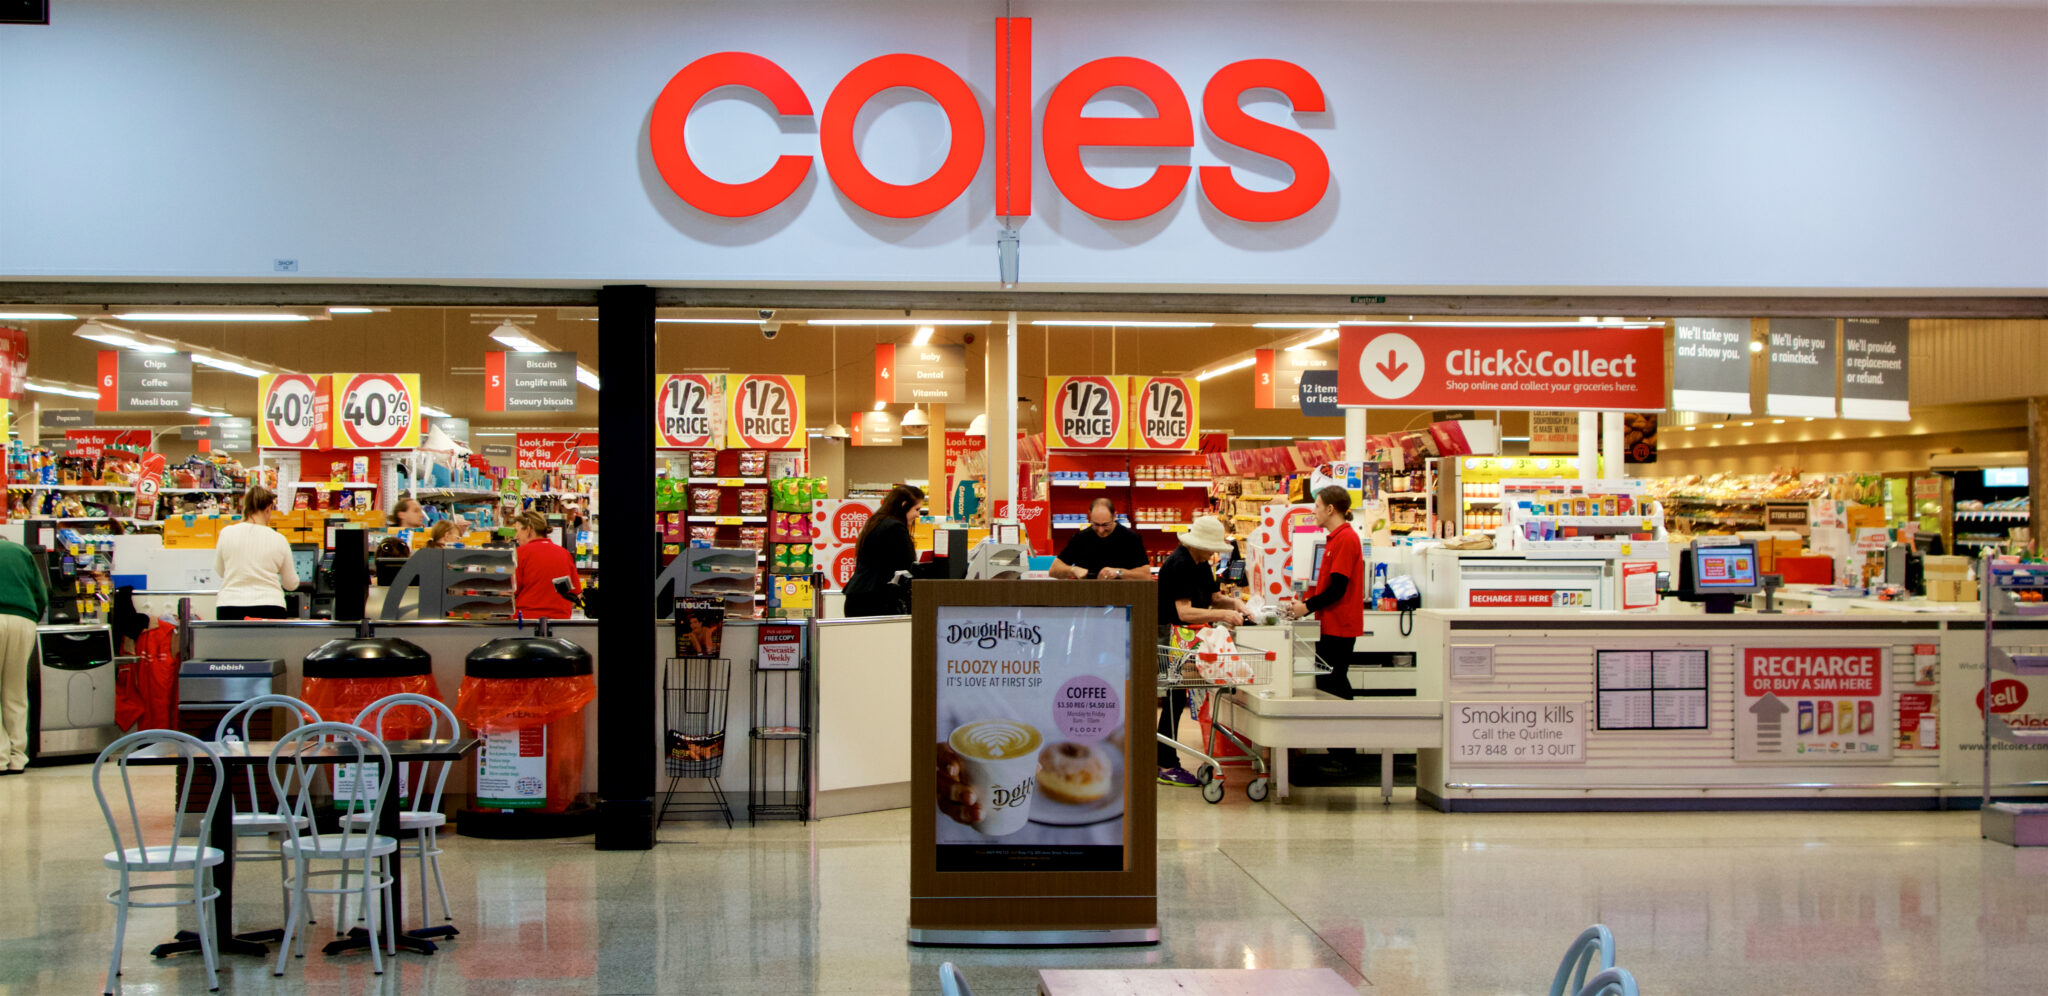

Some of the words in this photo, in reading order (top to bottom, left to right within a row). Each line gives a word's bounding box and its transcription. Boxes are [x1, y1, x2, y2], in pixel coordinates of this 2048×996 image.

[650, 17, 1330, 222] coles
[1678, 326, 1700, 340] We'll
[1702, 328, 1722, 341] take
[1723, 332, 1739, 345] you
[1772, 333, 1792, 346] We'll
[1793, 336, 1810, 351] give
[1811, 339, 1826, 350] you
[1847, 338, 1867, 352] We'll
[1868, 341, 1897, 354] provide
[920, 352, 941, 362] Baby
[1678, 344, 1696, 356] and
[1698, 344, 1721, 358] show
[1722, 349, 1740, 362] you.
[1772, 352, 1778, 362] a
[1778, 350, 1819, 364] raincheck.
[144, 360, 167, 370] Chips
[526, 360, 557, 368] Biscuits
[1446, 349, 1637, 378] Click&Collect
[1846, 358, 1853, 367] a
[1854, 356, 1902, 370] replacement
[880, 368, 890, 379] 4
[916, 370, 944, 379] Dental
[1262, 373, 1270, 384] 3
[1846, 373, 1856, 382] or
[1857, 371, 1884, 384] refund.
[104, 374, 112, 386] 6
[141, 378, 168, 387] Coffee
[492, 375, 500, 387] 5
[515, 378, 548, 388] Longlife
[550, 378, 568, 386] milk
[912, 389, 948, 397] Vitamins
[1302, 384, 1312, 393] 12
[1314, 384, 1338, 393] item
[1446, 380, 1469, 392] Shop
[1471, 381, 1499, 391] online
[1501, 381, 1518, 391] and
[1520, 382, 1549, 392] collect
[1551, 384, 1572, 393] your
[1573, 383, 1614, 394] groceries
[1616, 382, 1638, 392] here.
[130, 398, 159, 406] Muesli
[160, 398, 179, 406] bars
[509, 398, 542, 407] Savoury
[544, 398, 574, 406] biscuits
[668, 380, 705, 416] 1/2
[746, 380, 786, 416] 1/2
[1067, 382, 1108, 417] 1/2
[1150, 383, 1184, 418] 1/2
[1318, 394, 1338, 403] less
[344, 392, 408, 426] 40%
[302, 416, 313, 427] OF
[388, 416, 408, 426] OFF
[666, 417, 708, 434] PRICE
[744, 418, 790, 434] PRICE
[1064, 419, 1111, 436] PRICE
[1148, 420, 1186, 437] PRICE
[92, 436, 106, 444] for
[520, 438, 540, 446] Look
[542, 438, 554, 446] for
[946, 438, 968, 446] Look
[969, 438, 981, 446] for
[86, 447, 101, 456] Big
[536, 450, 550, 459] Big
[520, 460, 537, 468] Red
[538, 460, 562, 468] Hand
[840, 512, 868, 520] coles
[840, 527, 860, 539] BA
[1472, 594, 1512, 602] RECHARGE
[1528, 594, 1548, 602] HERE
[762, 646, 796, 654] Newcastle
[767, 654, 790, 664] Weekly
[209, 664, 245, 672] Rubbish
[947, 660, 998, 674] FLOOZY
[1001, 660, 1040, 674] HOUR
[1752, 656, 1874, 676] RECHARGE
[946, 677, 962, 687] IT'S
[964, 677, 987, 687] LOVE
[989, 677, 1000, 687] AT
[1002, 677, 1026, 687] FIRST
[1028, 677, 1042, 688] SIP
[1753, 678, 1772, 690] OR
[1773, 678, 1800, 690] BUY
[1801, 678, 1812, 690] A
[1814, 678, 1838, 690] SIM
[1840, 678, 1872, 690] HERE
[1066, 687, 1106, 699] COFFEE
[1462, 706, 1537, 728] Smoking
[1544, 706, 1574, 724] kills
[1472, 728, 1494, 740] Call
[1498, 728, 1516, 740] the
[1520, 728, 1564, 741] Quitline
[1461, 744, 1482, 756] 137
[1484, 744, 1508, 756] 848
[1514, 746, 1526, 756] or
[1531, 744, 1544, 756] 13
[1547, 744, 1576, 756] QUIT
